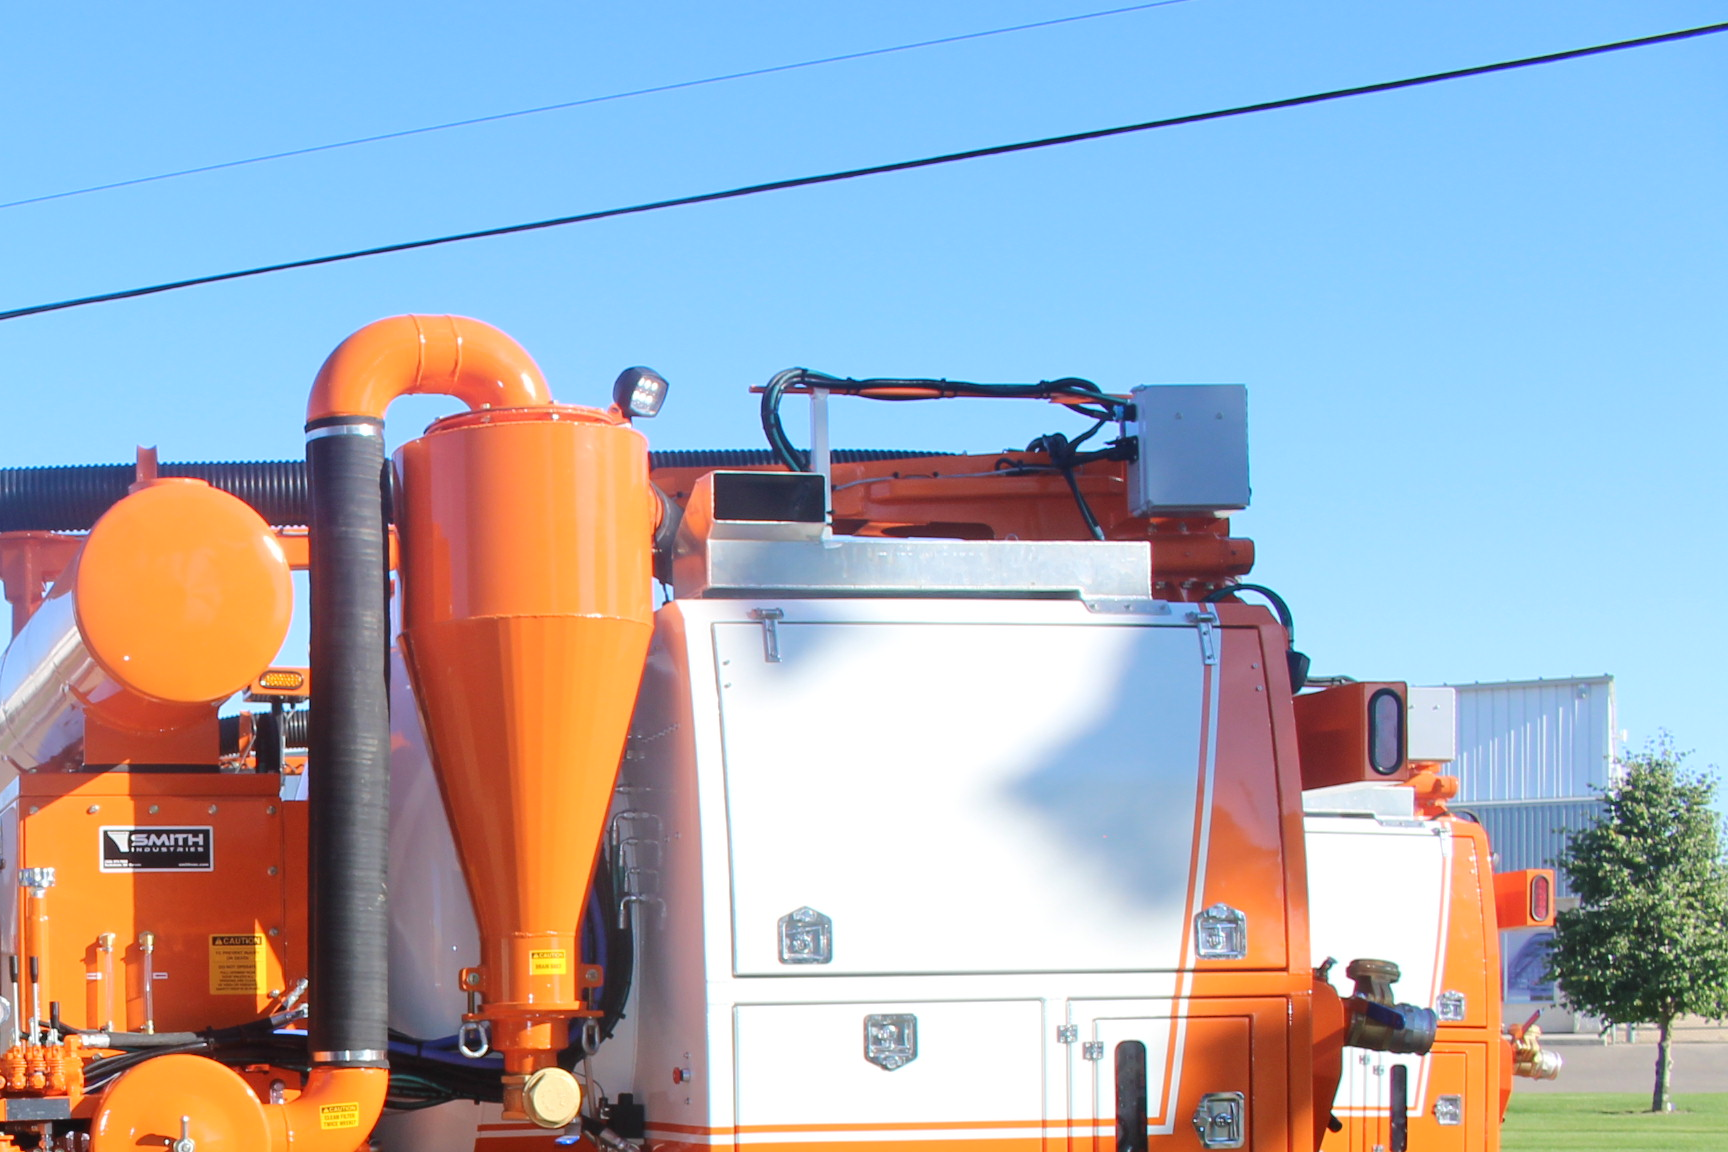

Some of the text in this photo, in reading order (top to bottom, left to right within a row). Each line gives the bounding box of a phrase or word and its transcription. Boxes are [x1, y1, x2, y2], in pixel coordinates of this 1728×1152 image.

[131, 833, 204, 846] SMITH
[223, 937, 261, 945] CAUTION
[329, 1105, 356, 1113] CAUTION
